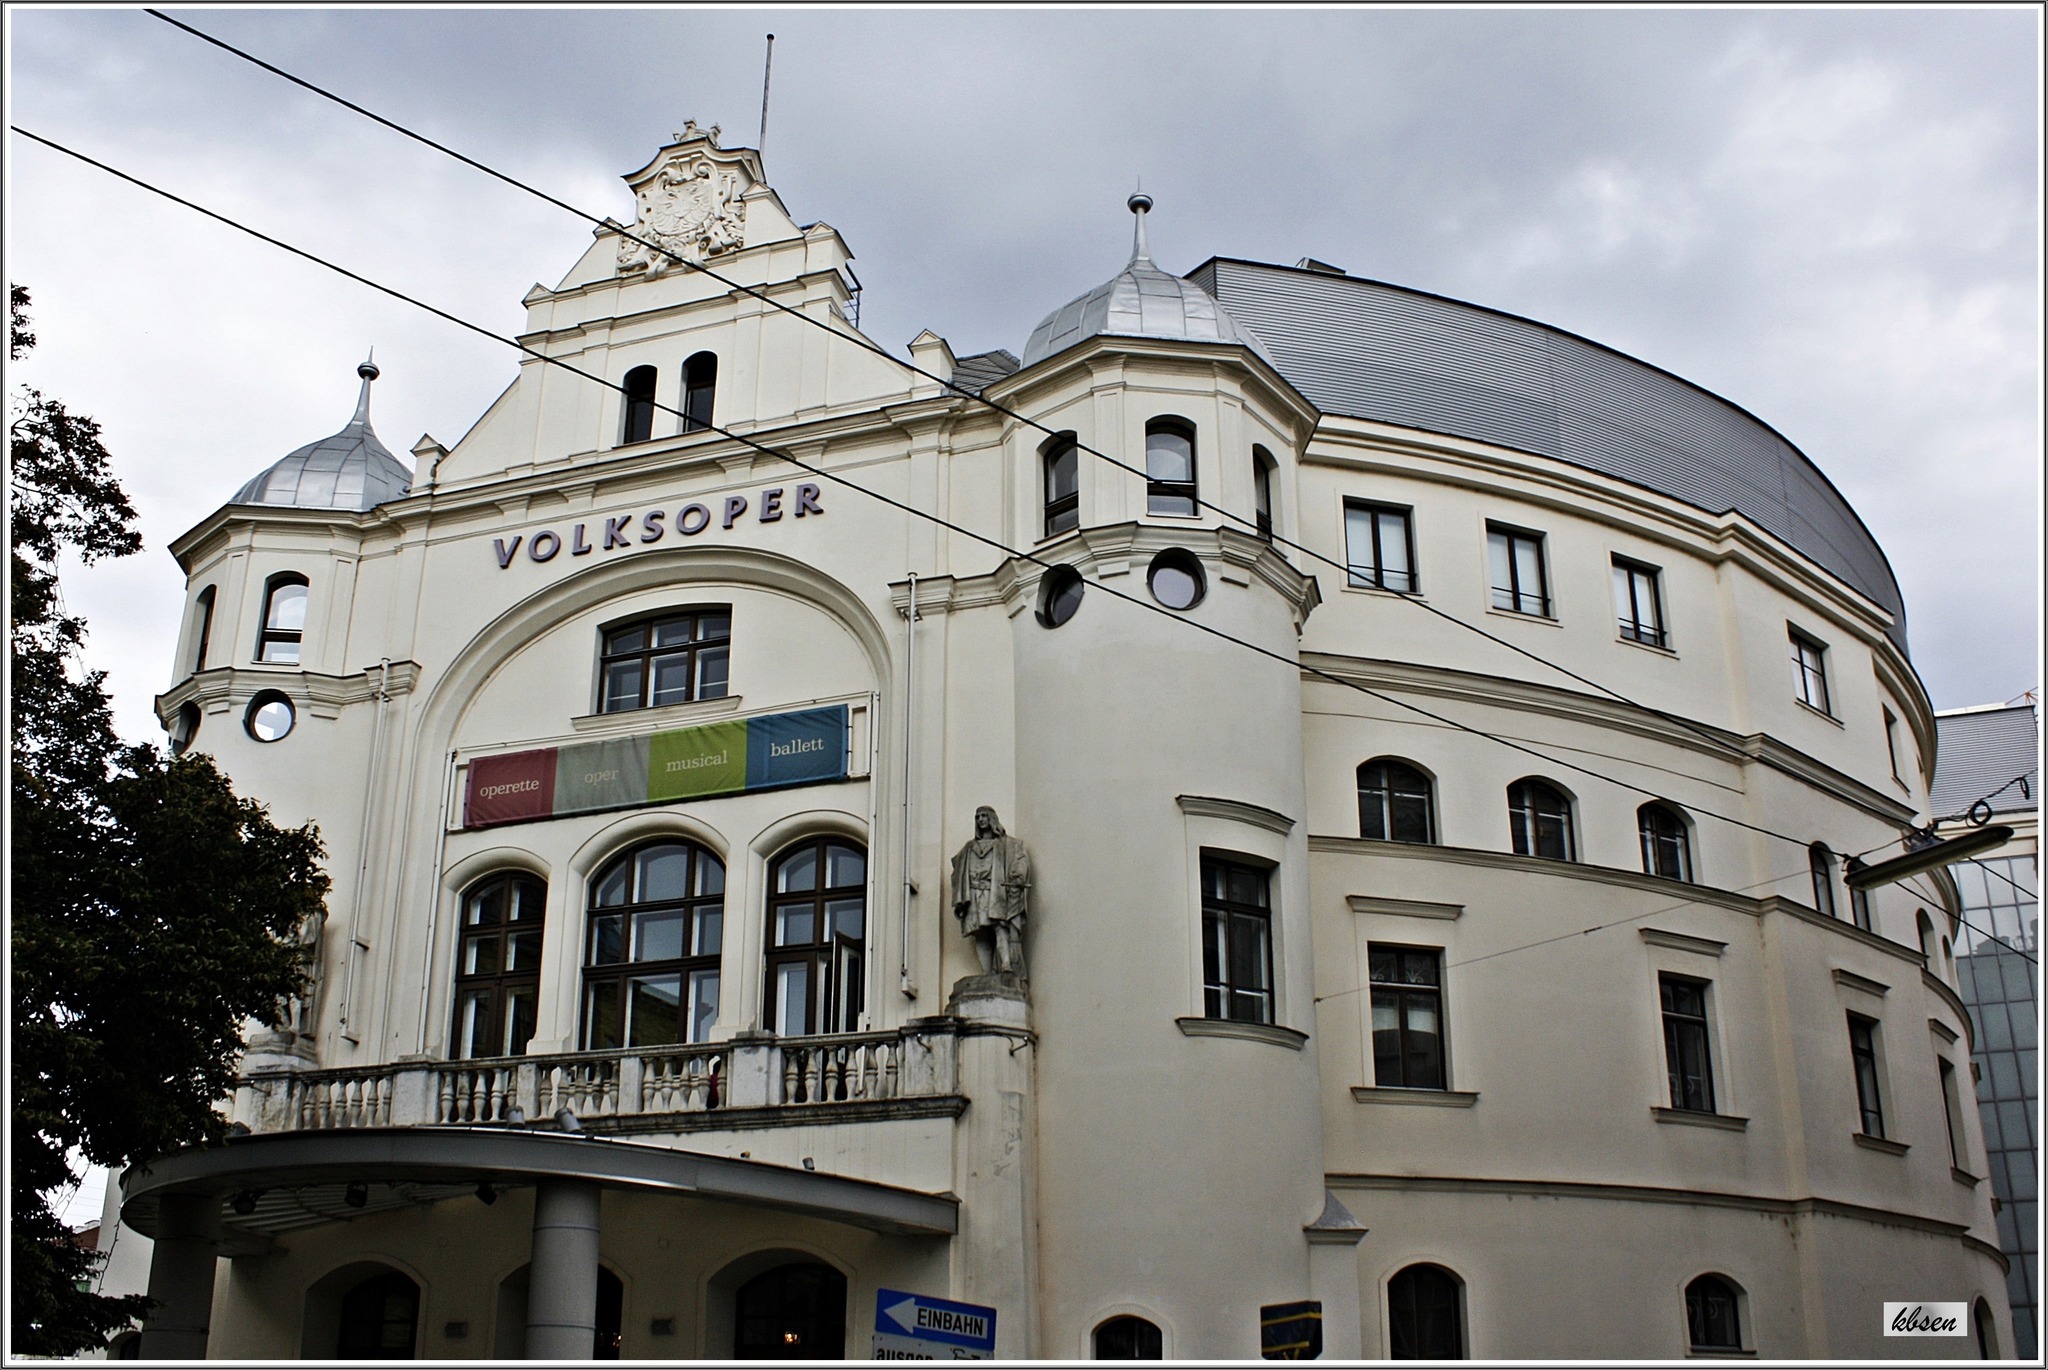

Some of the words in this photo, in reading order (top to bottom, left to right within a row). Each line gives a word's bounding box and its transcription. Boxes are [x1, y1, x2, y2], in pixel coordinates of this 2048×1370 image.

[493, 482, 824, 569] VOLKSOPER
[480, 779, 539, 799] operette
[584, 769, 619, 785] oper
[666, 750, 728, 772] musical
[770, 738, 824, 757] ballett
[917, 1307, 984, 1337] EINBAHN
